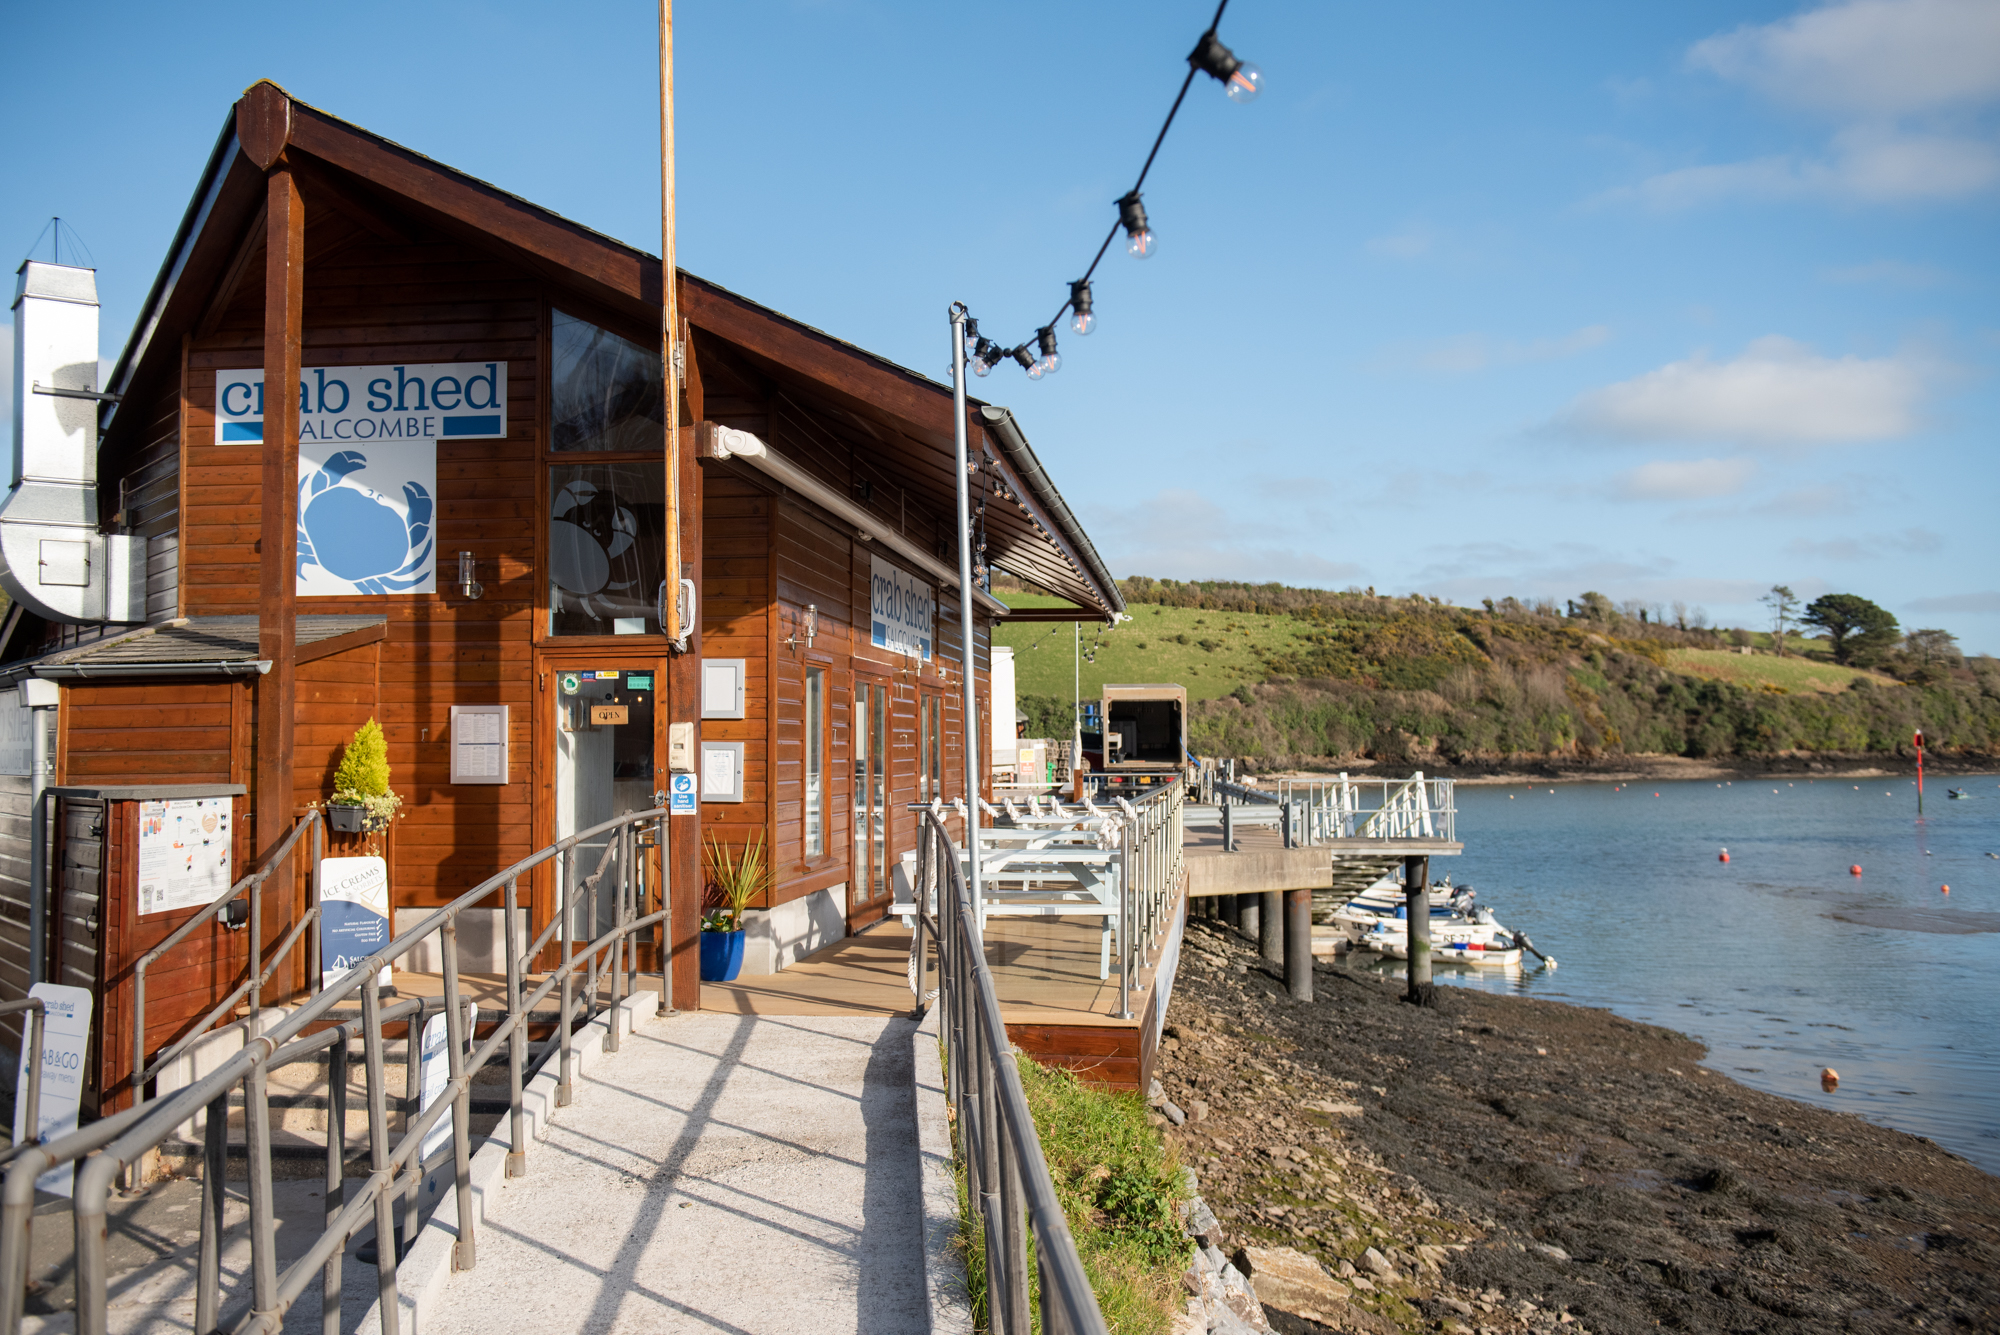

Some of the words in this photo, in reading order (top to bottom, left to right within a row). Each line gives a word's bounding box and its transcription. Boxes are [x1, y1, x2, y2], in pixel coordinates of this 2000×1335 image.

[367, 363, 501, 413] shed
[299, 416, 436, 440] ALCOMBE
[873, 570, 902, 623] crab
[905, 579, 931, 634] shed
[598, 711, 620, 720] OPEN
[323, 885, 341, 898] ICE
[341, 866, 380, 889] CREAMS
[59, 1001, 74, 1012] shed
